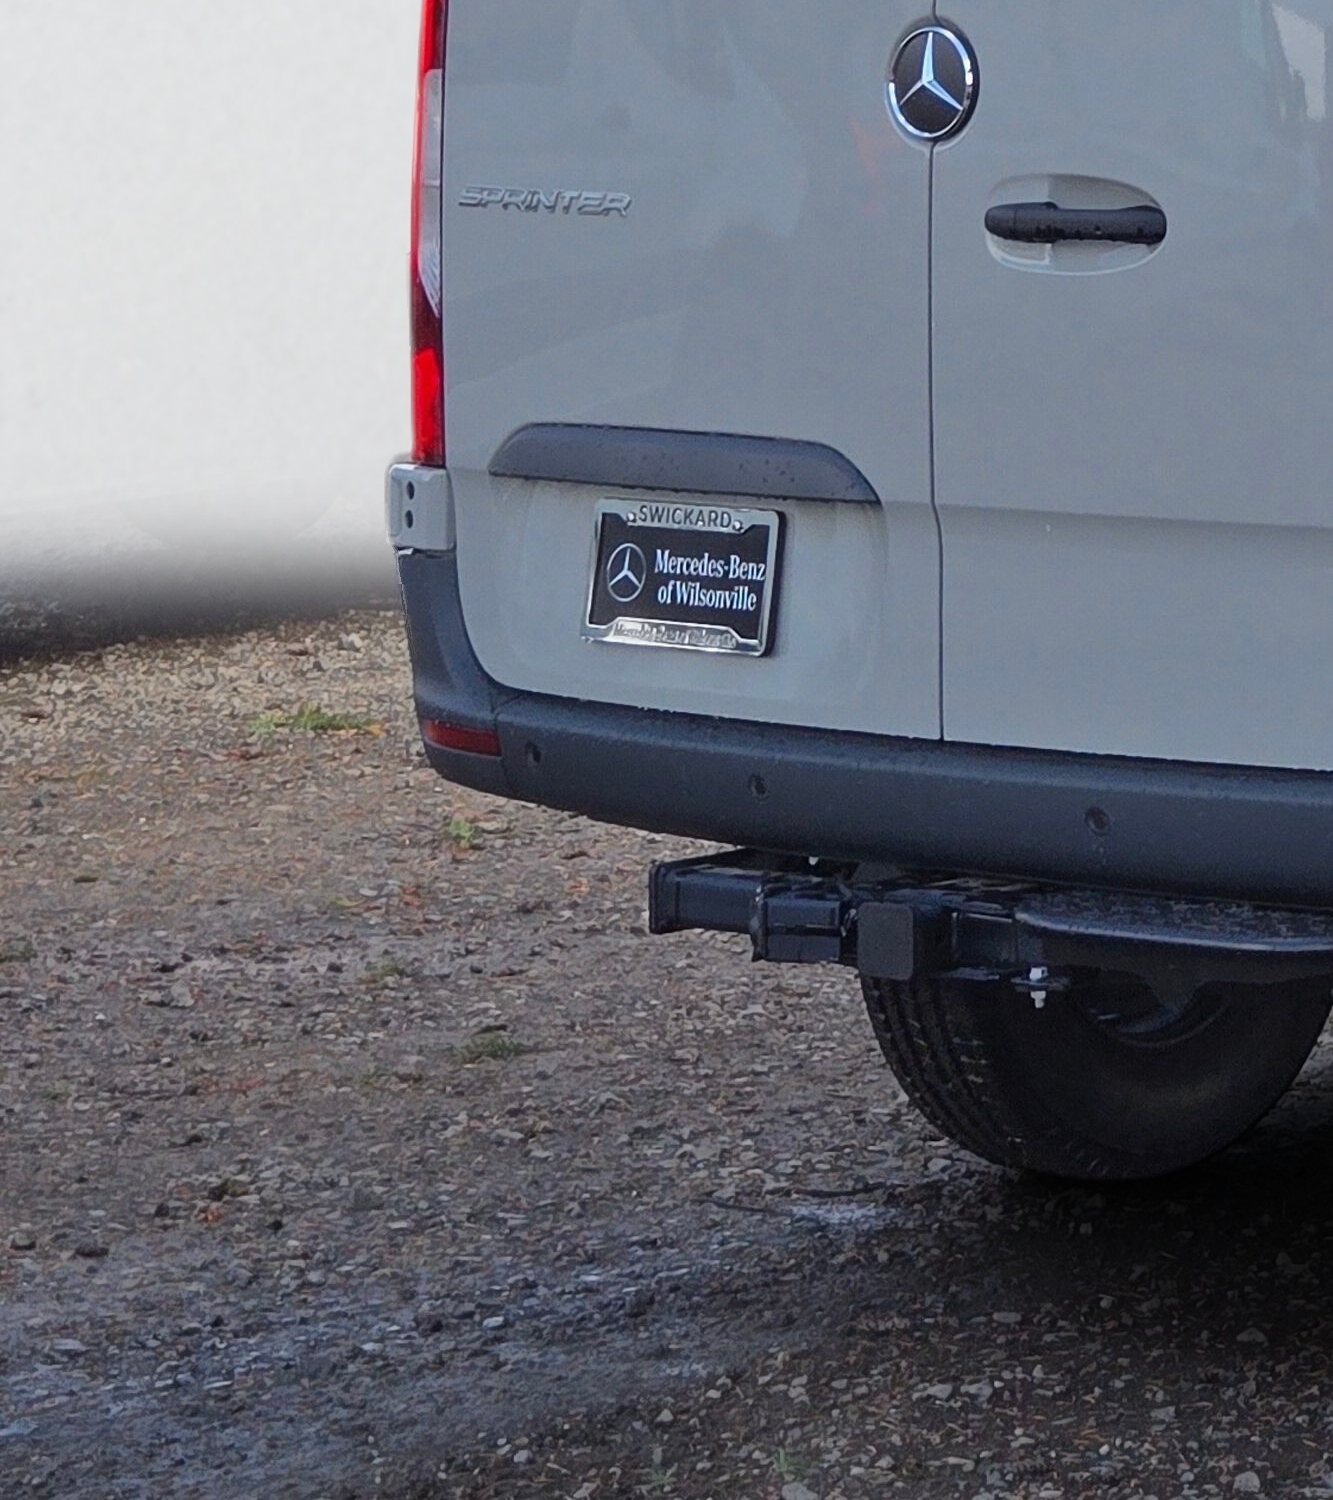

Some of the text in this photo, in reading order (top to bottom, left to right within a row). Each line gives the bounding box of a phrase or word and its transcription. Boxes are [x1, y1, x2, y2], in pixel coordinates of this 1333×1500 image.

[459, 184, 632, 217] SPRINTER
[638, 505, 732, 529] SWICKARD
[655, 549, 766, 581] Mercedes-Benz
[657, 580, 757, 611] of Wilsonville
